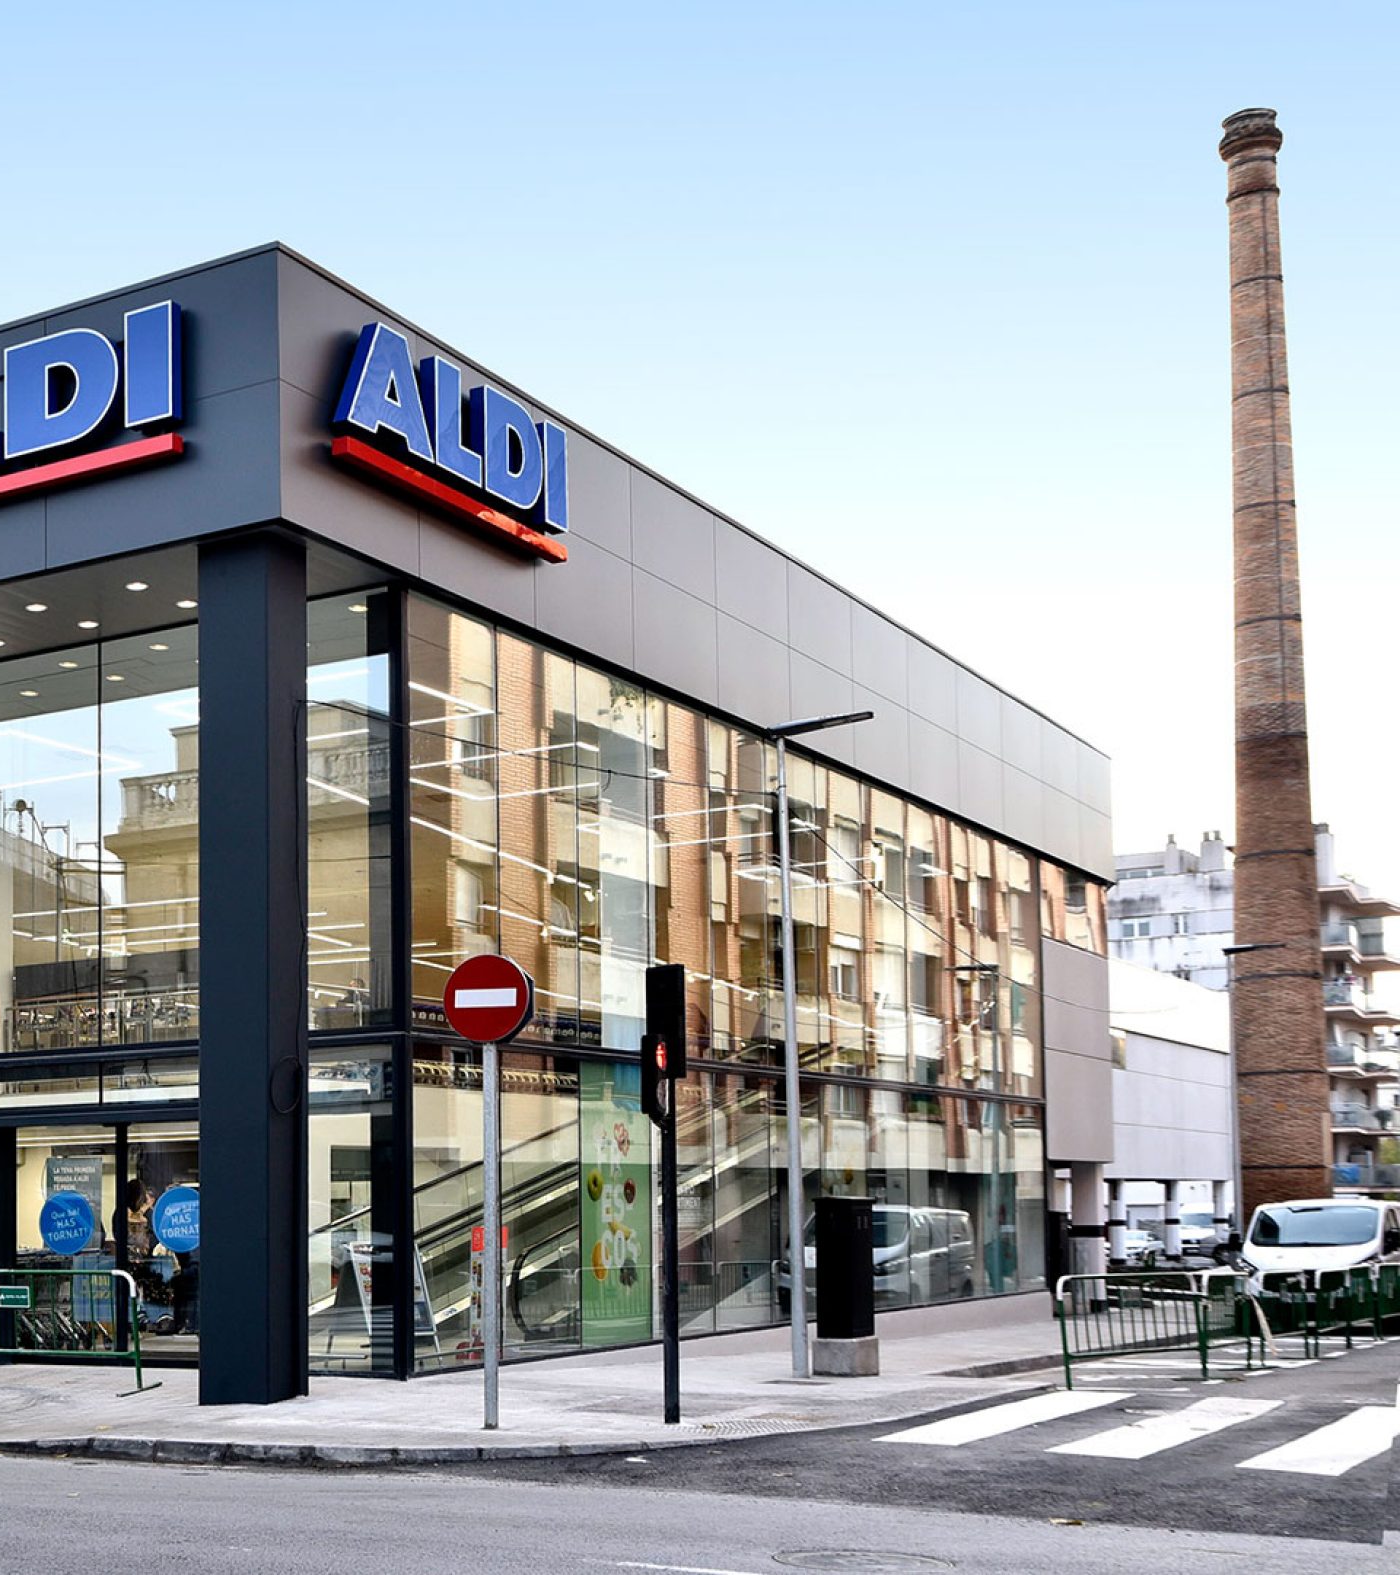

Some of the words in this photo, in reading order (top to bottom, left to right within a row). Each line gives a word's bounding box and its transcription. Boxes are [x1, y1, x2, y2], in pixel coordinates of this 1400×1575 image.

[332, 322, 570, 534] ALDI
[57, 1219, 76, 1229] HAS
[171, 1212, 192, 1225] HAS
